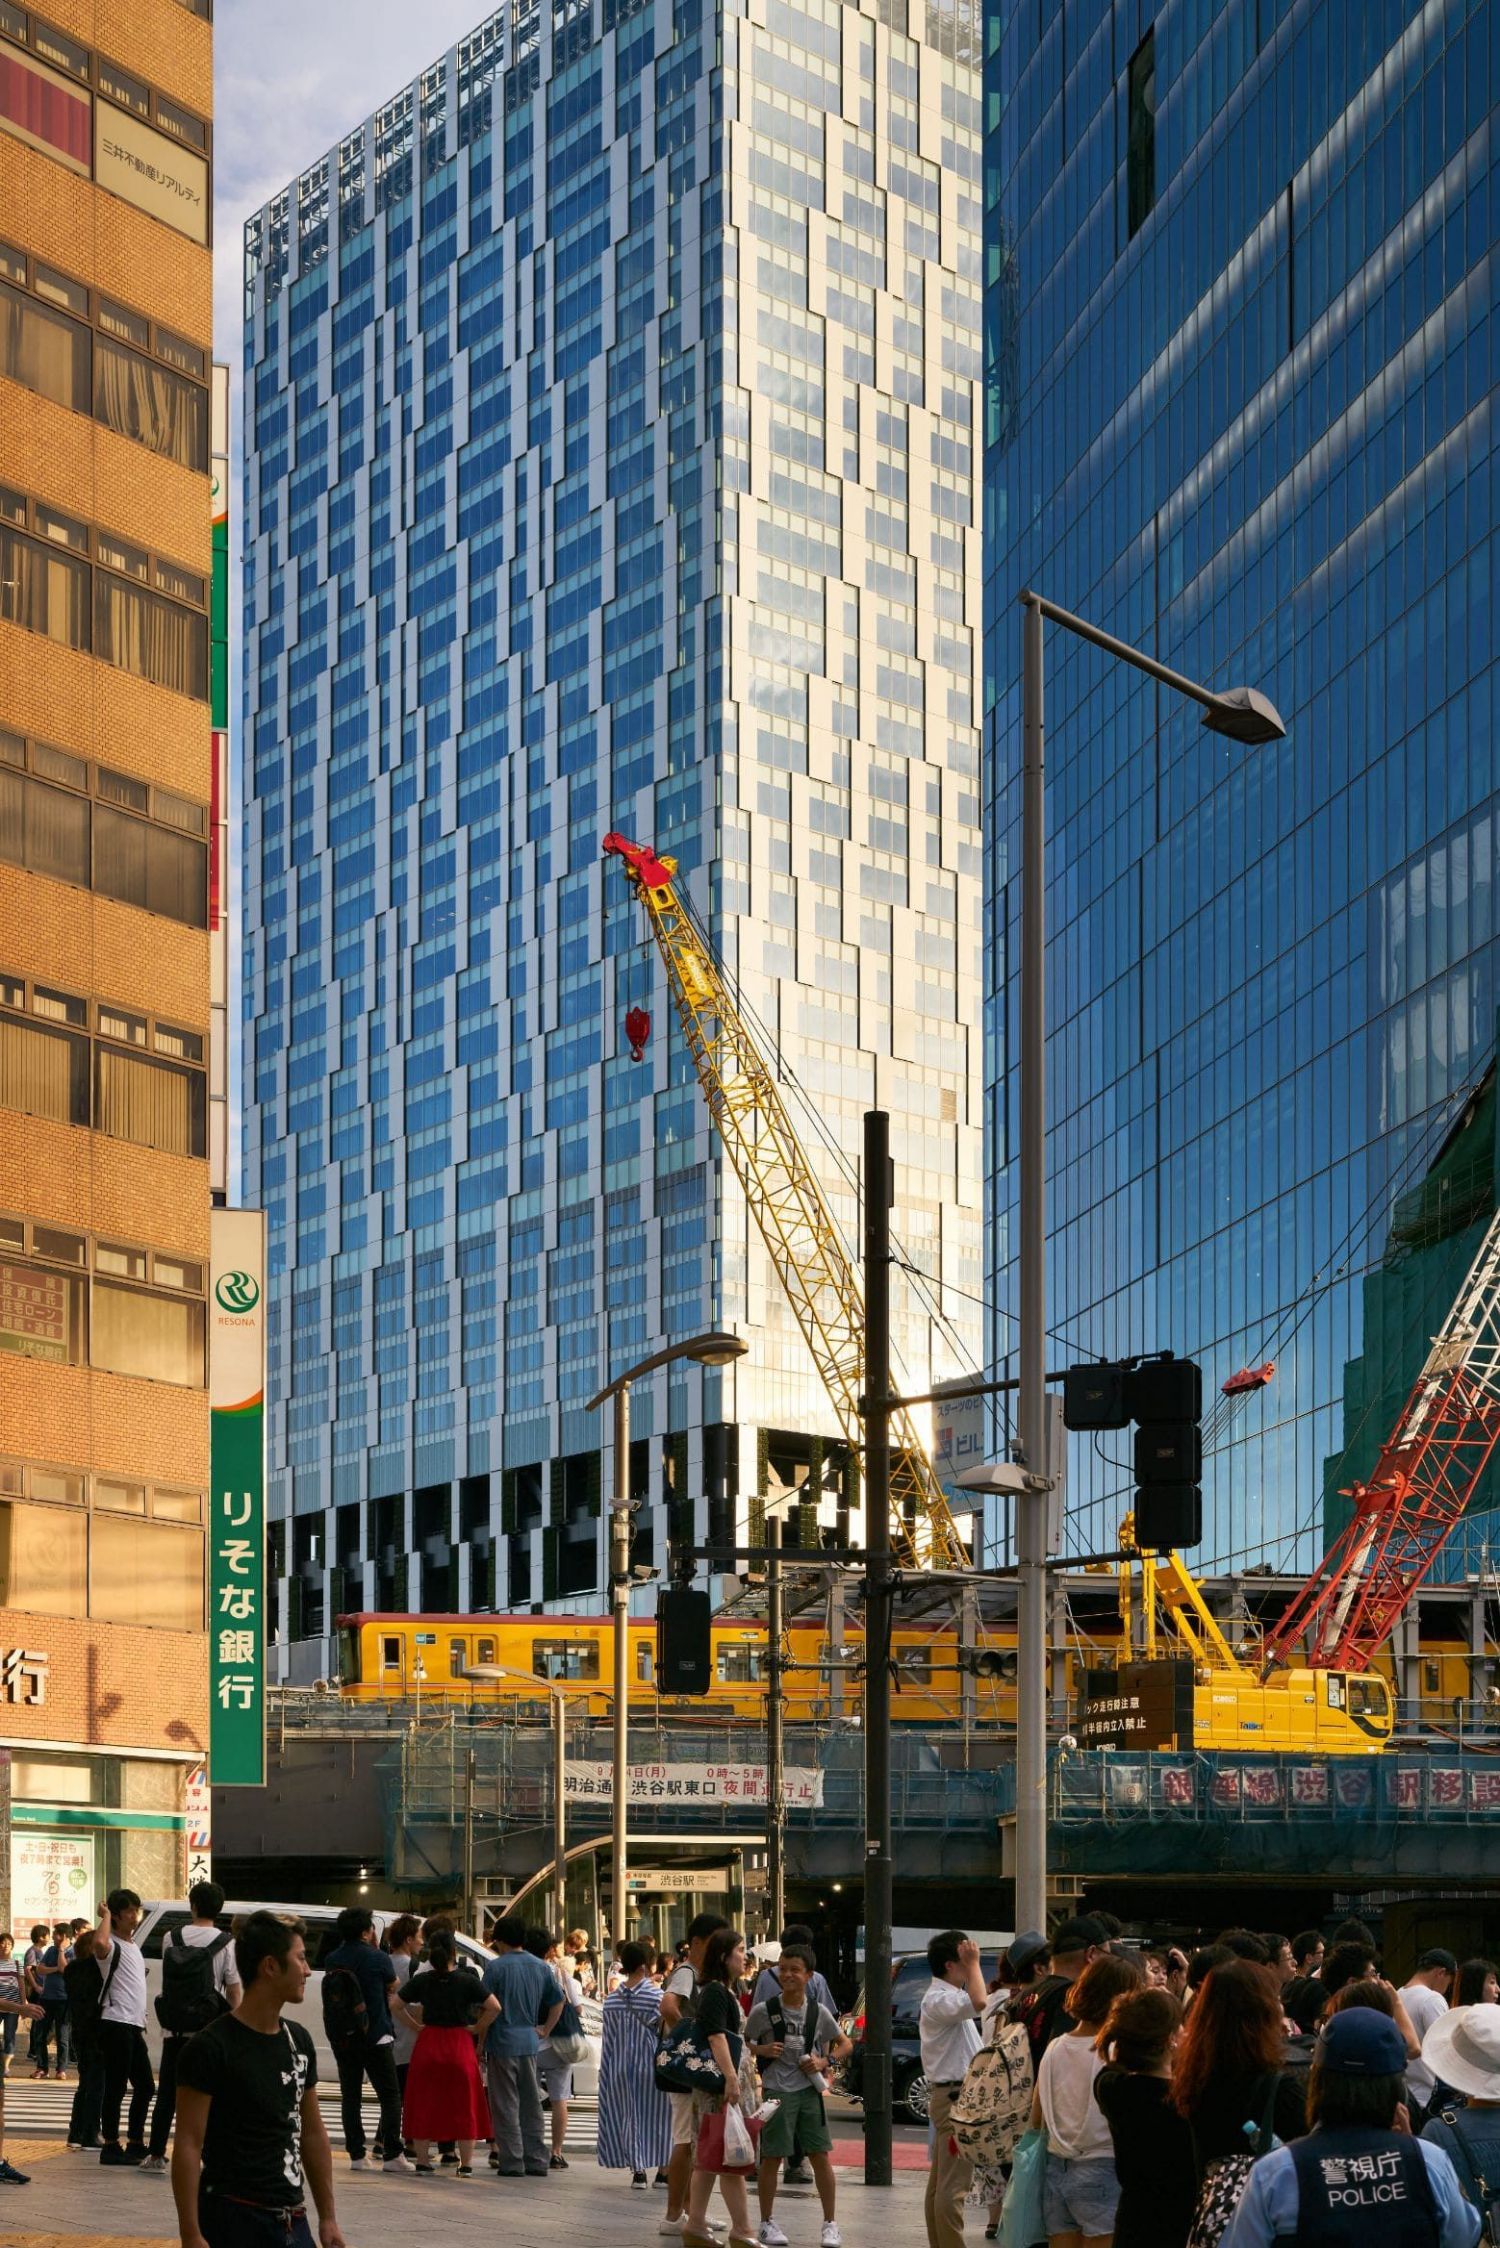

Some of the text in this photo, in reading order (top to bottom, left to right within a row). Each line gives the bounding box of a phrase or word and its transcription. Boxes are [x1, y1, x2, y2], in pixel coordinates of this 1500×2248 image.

[102, 138, 201, 207] 三井不動産リアルティ
[217, 1317, 256, 1327] RESONA
[956, 1431, 984, 1456] ビル
[218, 1491, 256, 1710] りそな銀行
[0, 1648, 49, 1705] 行
[187, 1820, 201, 1828] 2F
[660, 1874, 695, 1887] 渋谷駅
[1319, 2151, 1403, 2186] 警視庁
[1328, 2181, 1408, 2209] POLICE
